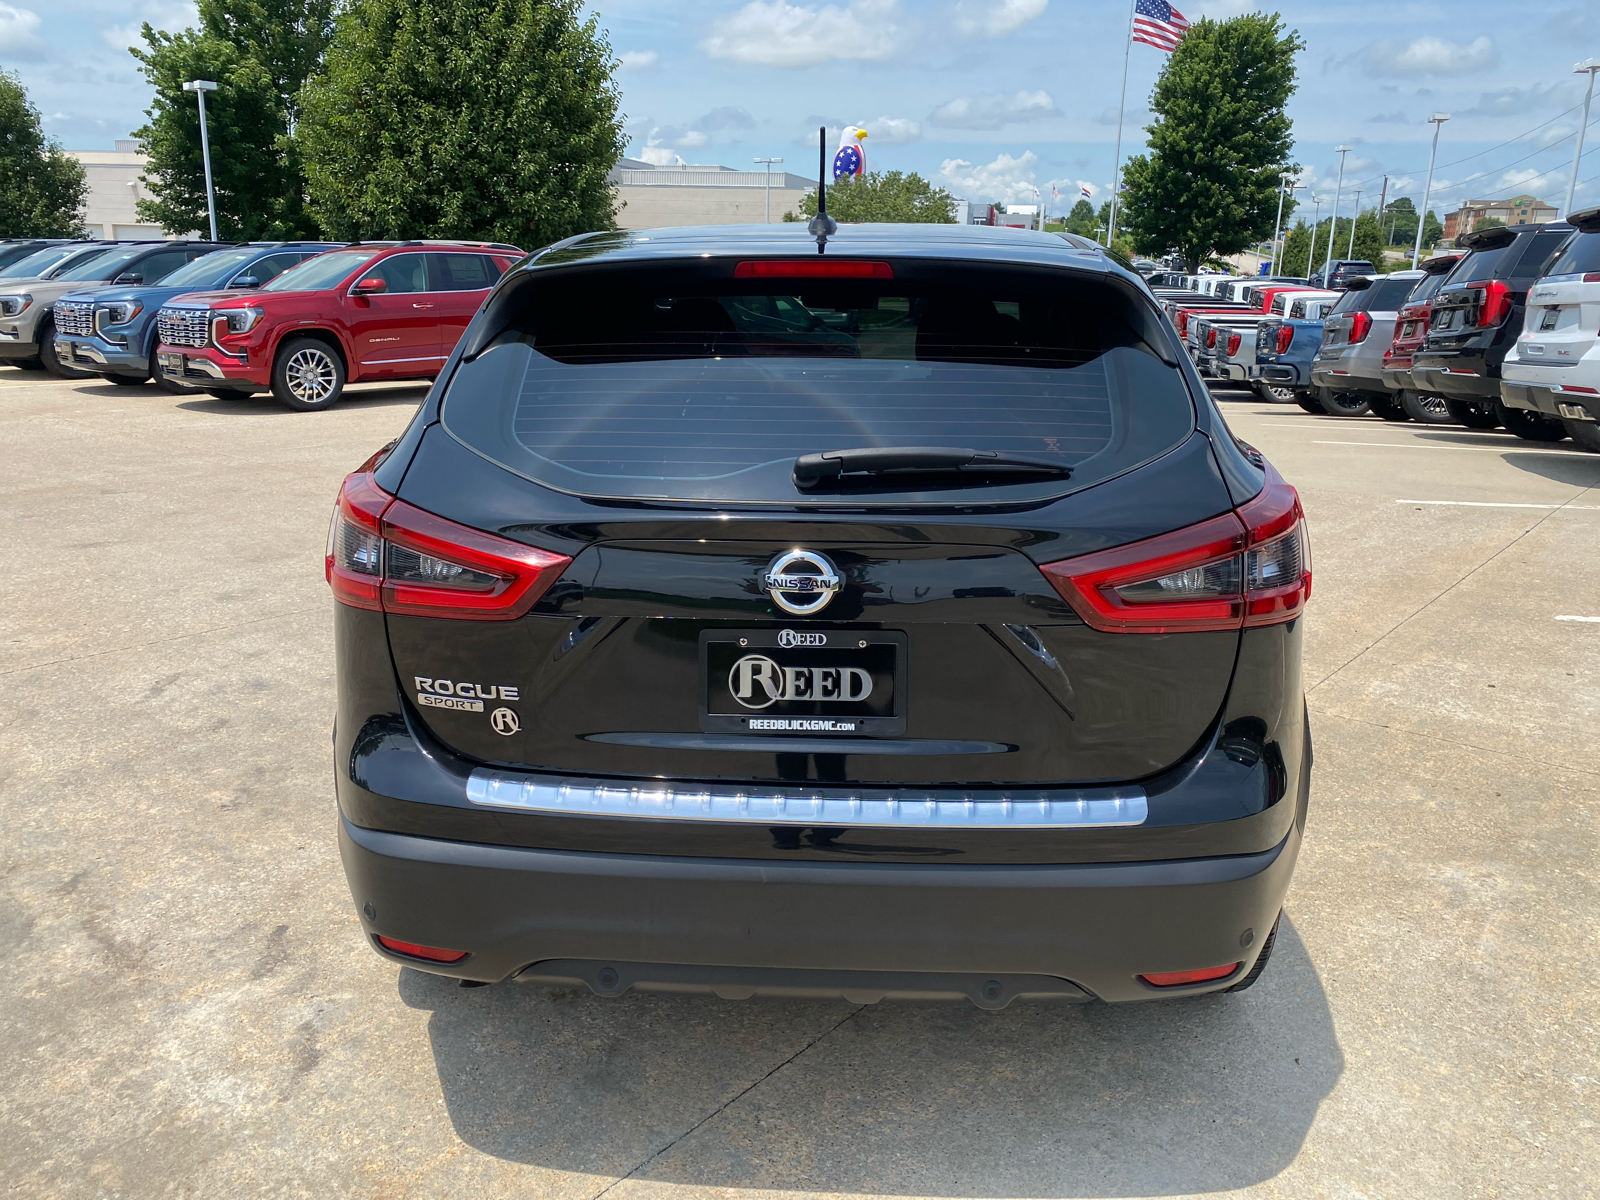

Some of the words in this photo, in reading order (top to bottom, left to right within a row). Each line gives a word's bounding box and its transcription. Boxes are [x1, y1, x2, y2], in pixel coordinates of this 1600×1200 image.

[772, 578, 831, 589] NISSAN
[778, 629, 827, 648] REED
[414, 676, 520, 701] ROGUE
[728, 654, 873, 709] REED
[424, 696, 477, 710] SPORT
